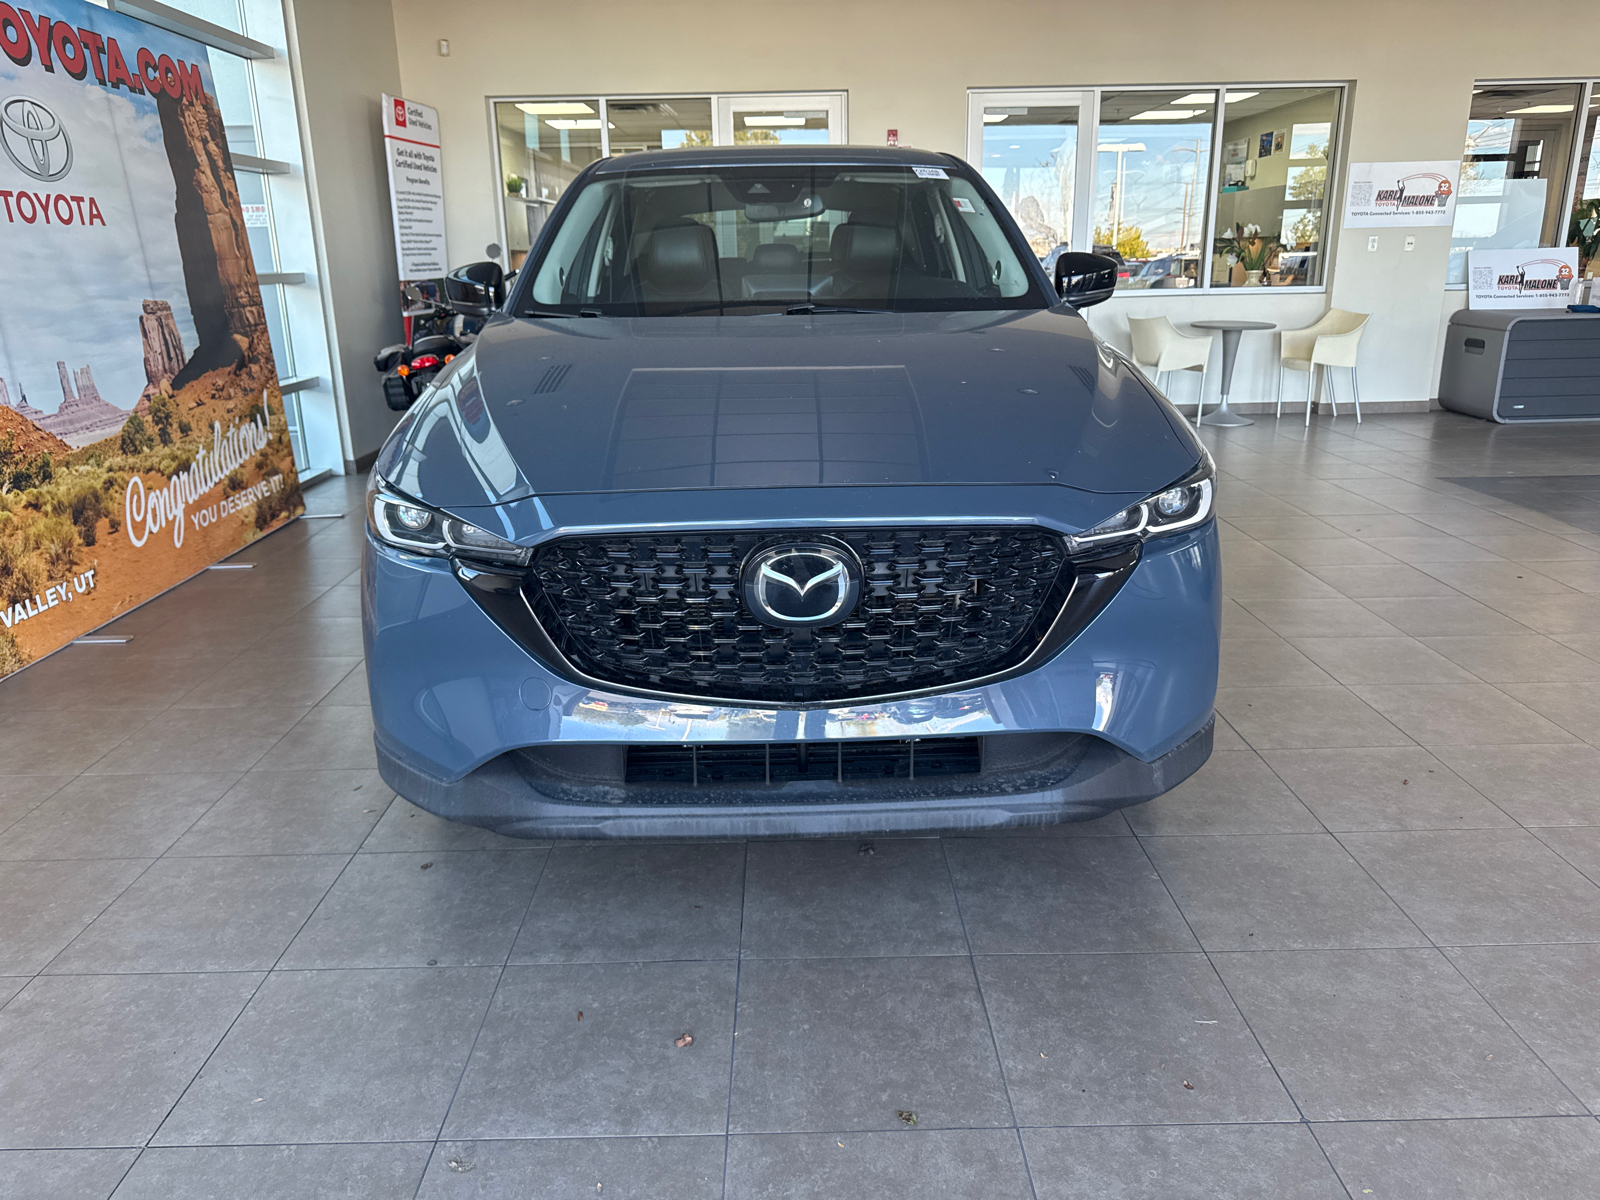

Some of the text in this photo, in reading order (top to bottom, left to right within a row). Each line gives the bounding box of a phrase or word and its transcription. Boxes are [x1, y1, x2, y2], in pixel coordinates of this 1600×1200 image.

[0, 190, 107, 226] TOYOTA
[1375, 190, 1437, 206] KARL MALONE
[1497, 275, 1558, 290] KARL MALONE
[125, 389, 273, 548] Congratulations!
[191, 473, 284, 530] YOU DESERVE IT!
[0, 569, 95, 628] VALLEY, UT
